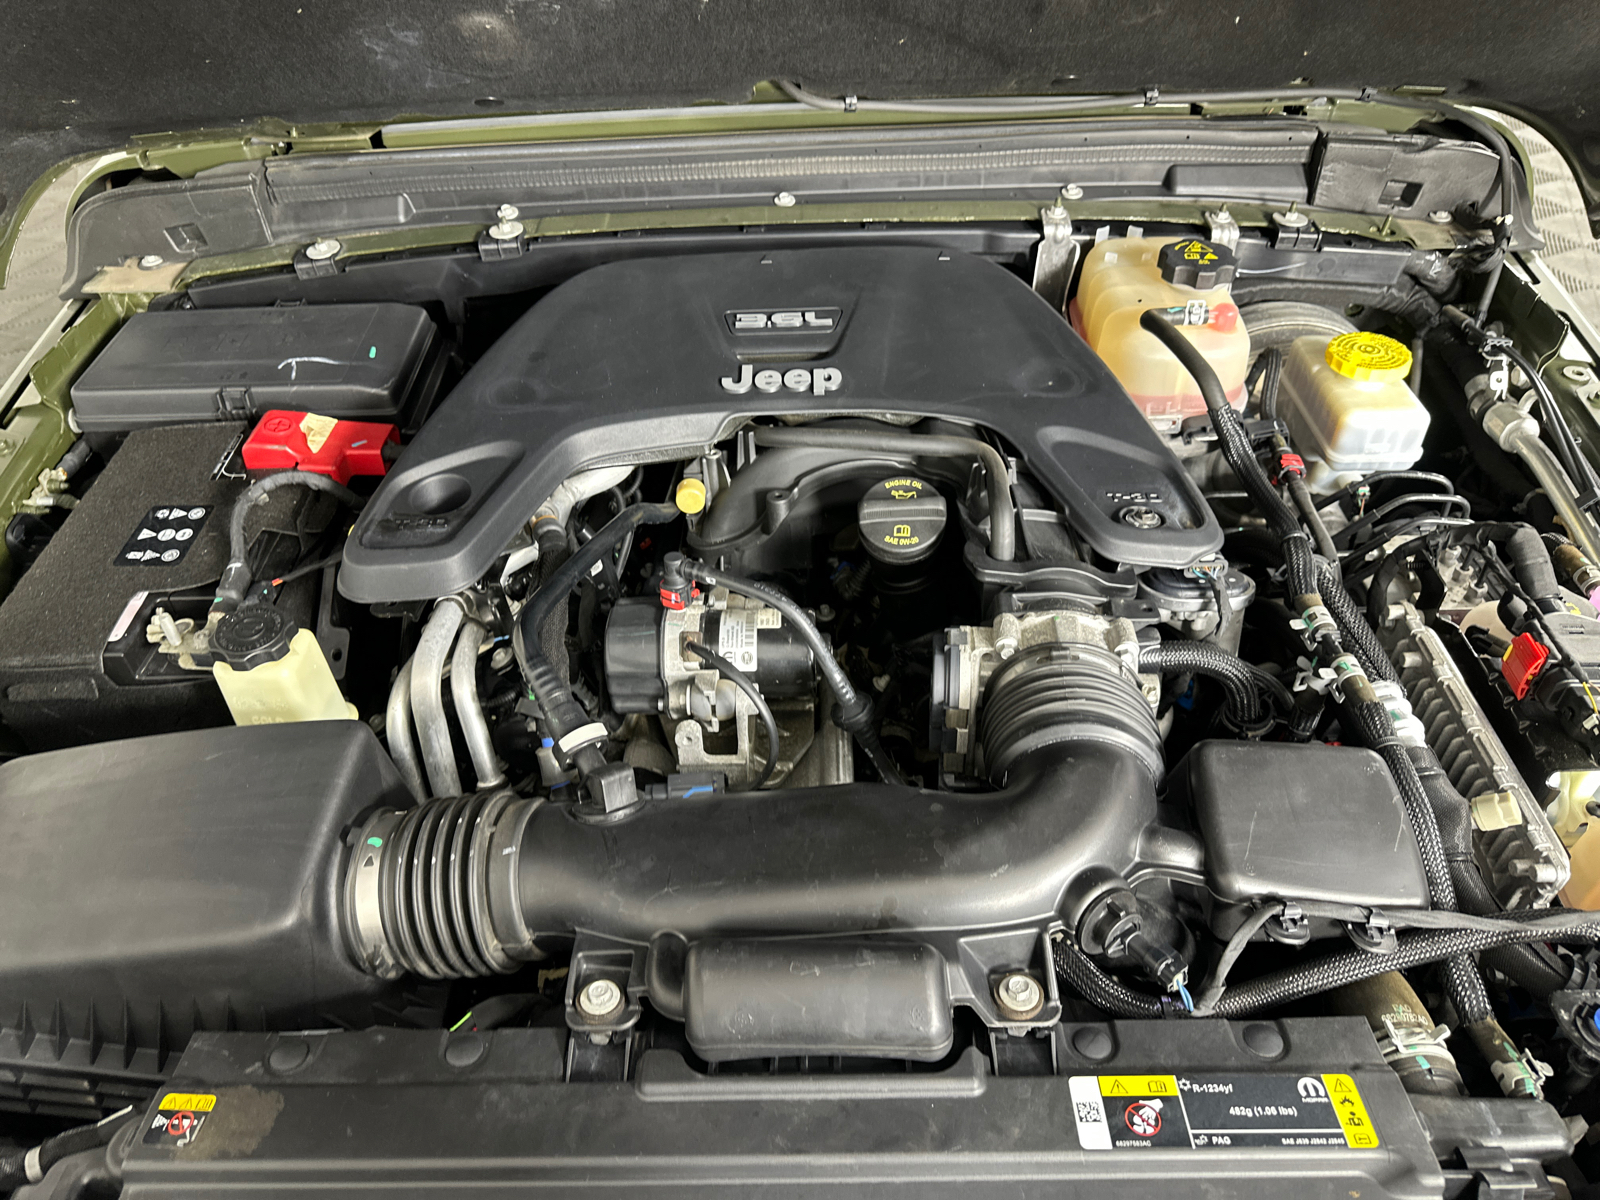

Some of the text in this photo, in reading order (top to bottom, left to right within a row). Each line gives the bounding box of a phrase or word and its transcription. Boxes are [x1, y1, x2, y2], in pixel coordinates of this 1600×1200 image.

[734, 311, 833, 329] 3.6L
[721, 364, 842, 396] Jeep
[884, 479, 922, 490] ENGINE OIL
[884, 535, 898, 545] SAE
[1278, 1105, 1298, 1117] lbs)
[1211, 1136, 1231, 1145] PAG
